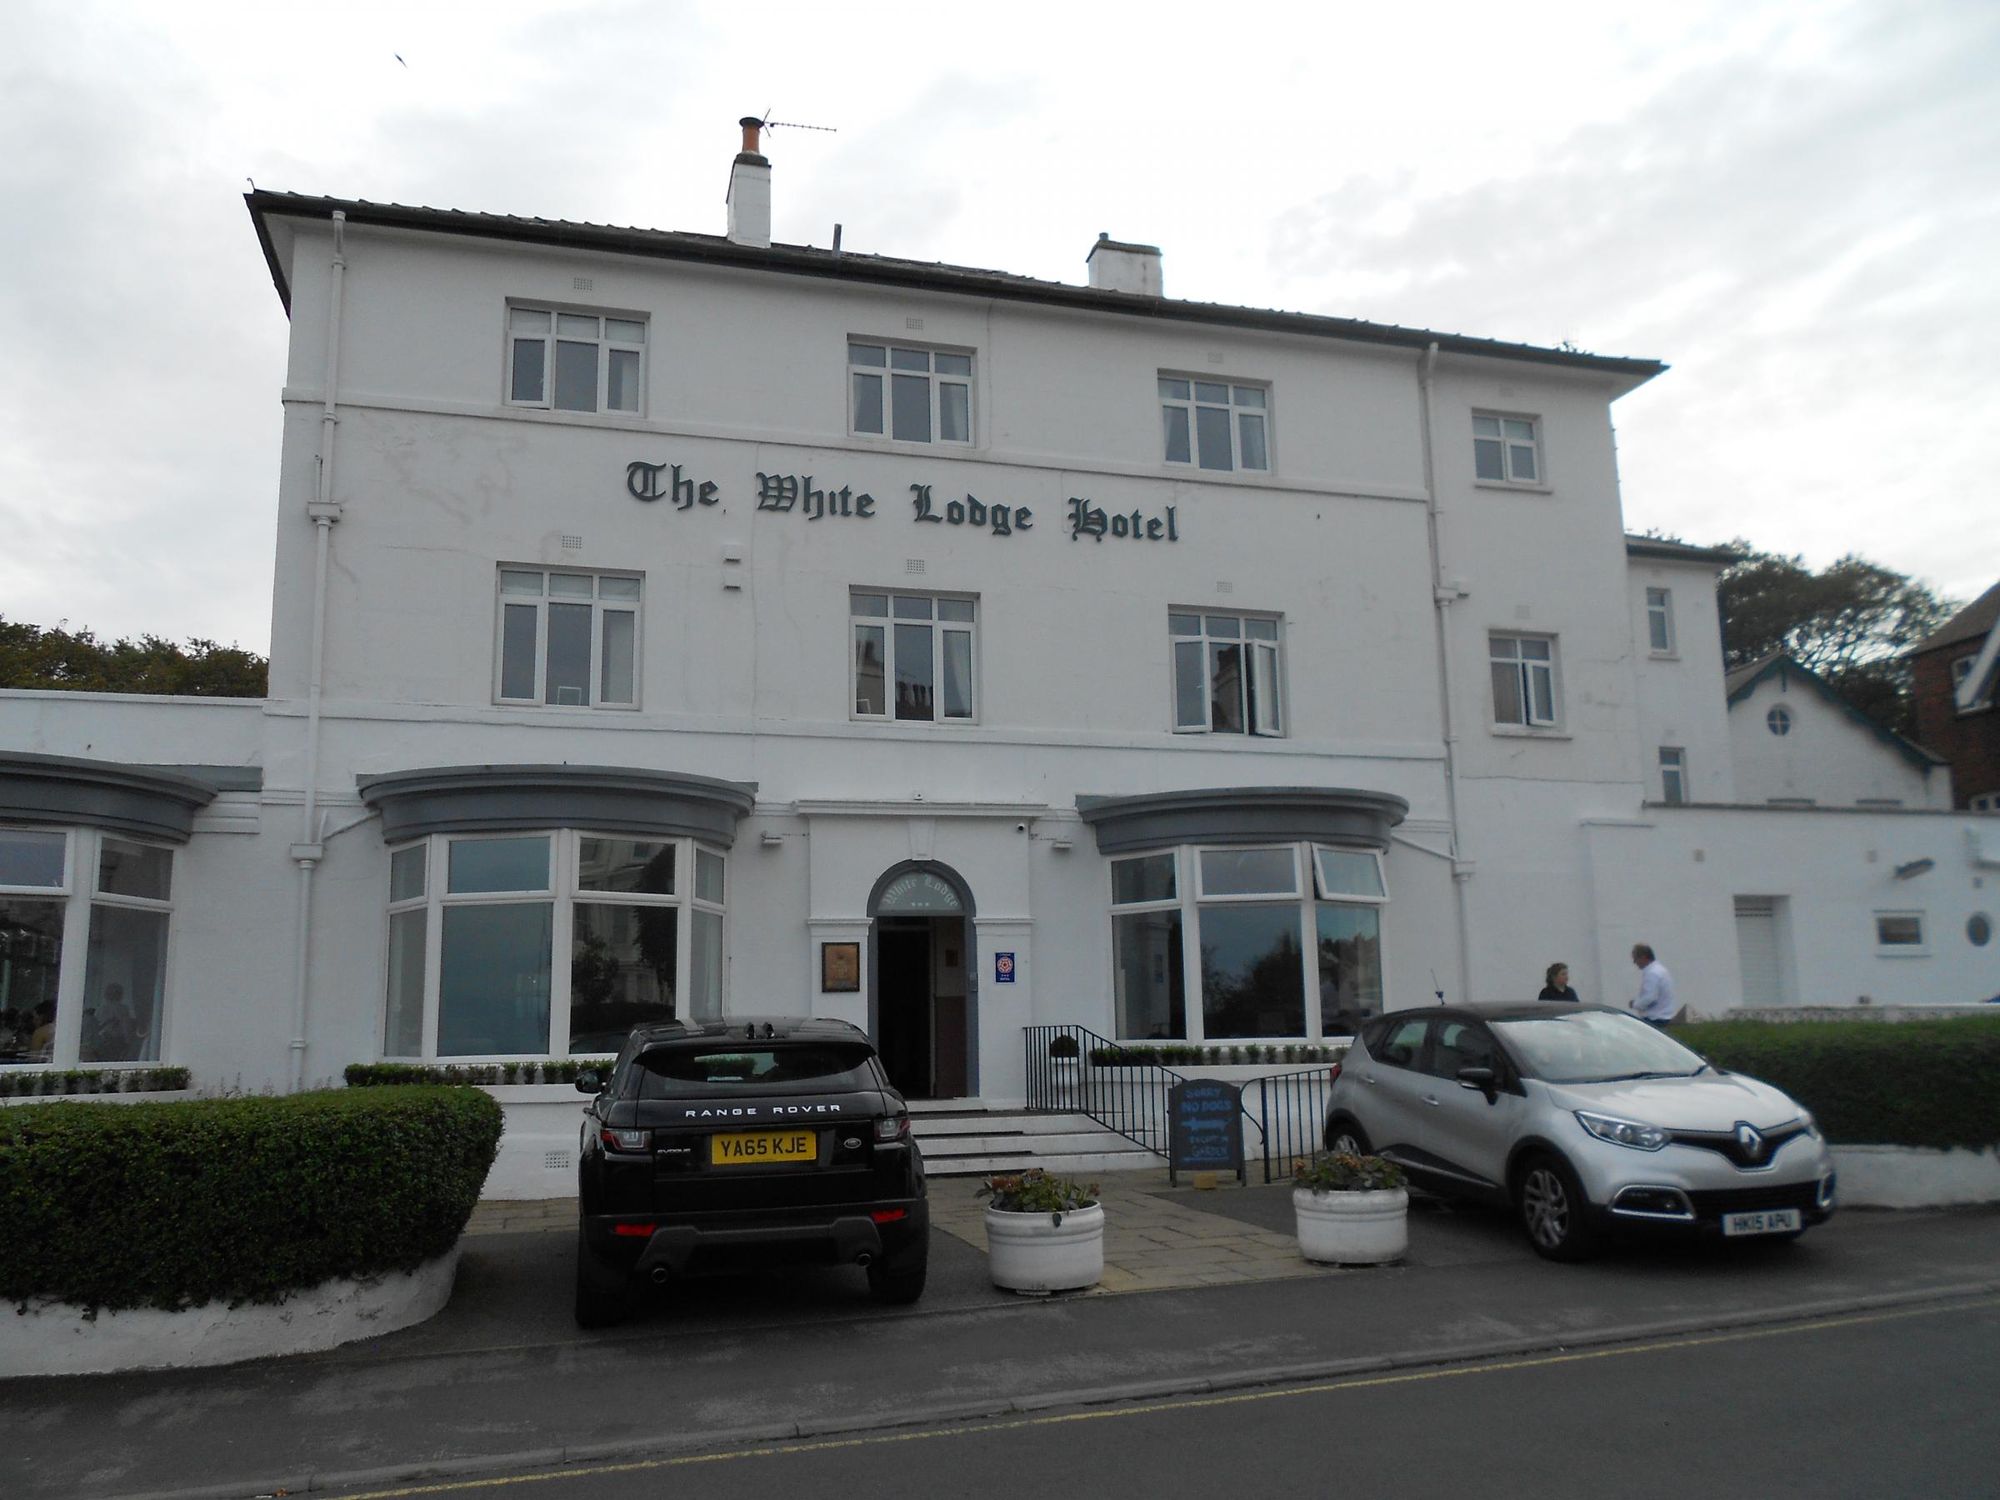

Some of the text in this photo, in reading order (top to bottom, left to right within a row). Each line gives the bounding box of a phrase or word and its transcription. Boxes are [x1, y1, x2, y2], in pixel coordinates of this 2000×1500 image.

[626, 461, 1179, 542] The White Lodge Hotel
[685, 1104, 841, 1118] RANGE ROVER
[1182, 1100, 1232, 1112] NO DOGS
[720, 1136, 808, 1158] YA65 KJE
